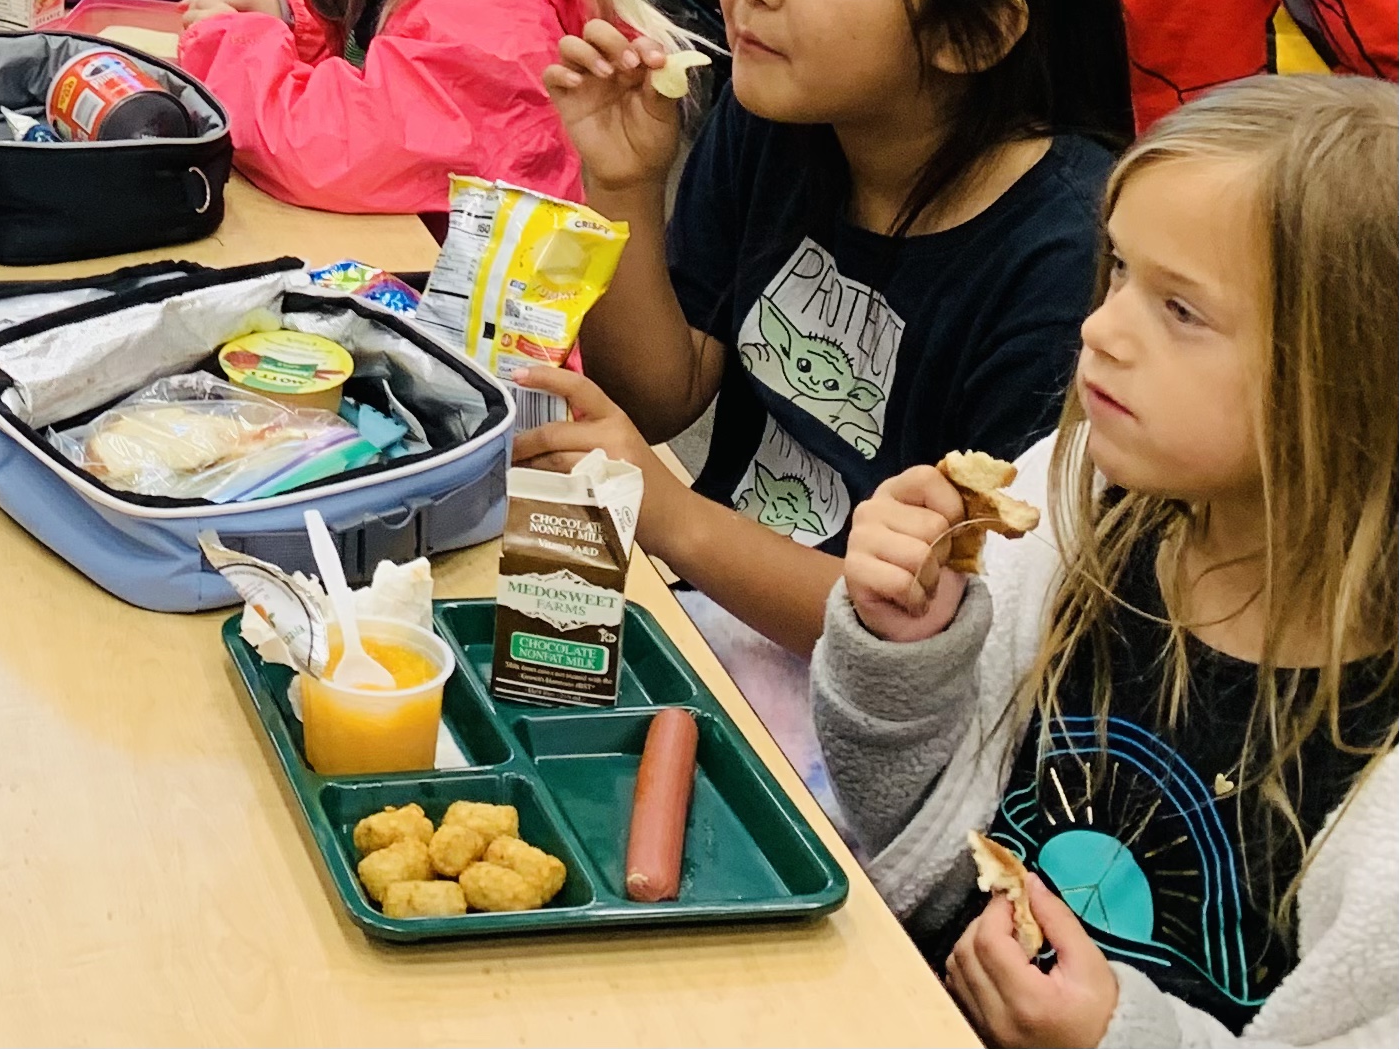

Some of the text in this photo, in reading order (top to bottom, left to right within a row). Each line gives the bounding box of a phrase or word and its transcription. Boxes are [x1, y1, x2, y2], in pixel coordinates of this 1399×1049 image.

[529, 523, 576, 539] NONFAT
[507, 581, 618, 609] MEDOSWEET
[535, 600, 587, 616] FARMS
[518, 637, 597, 659] CHOCOLATE
[518, 648, 596, 670] NONFAT MILK
